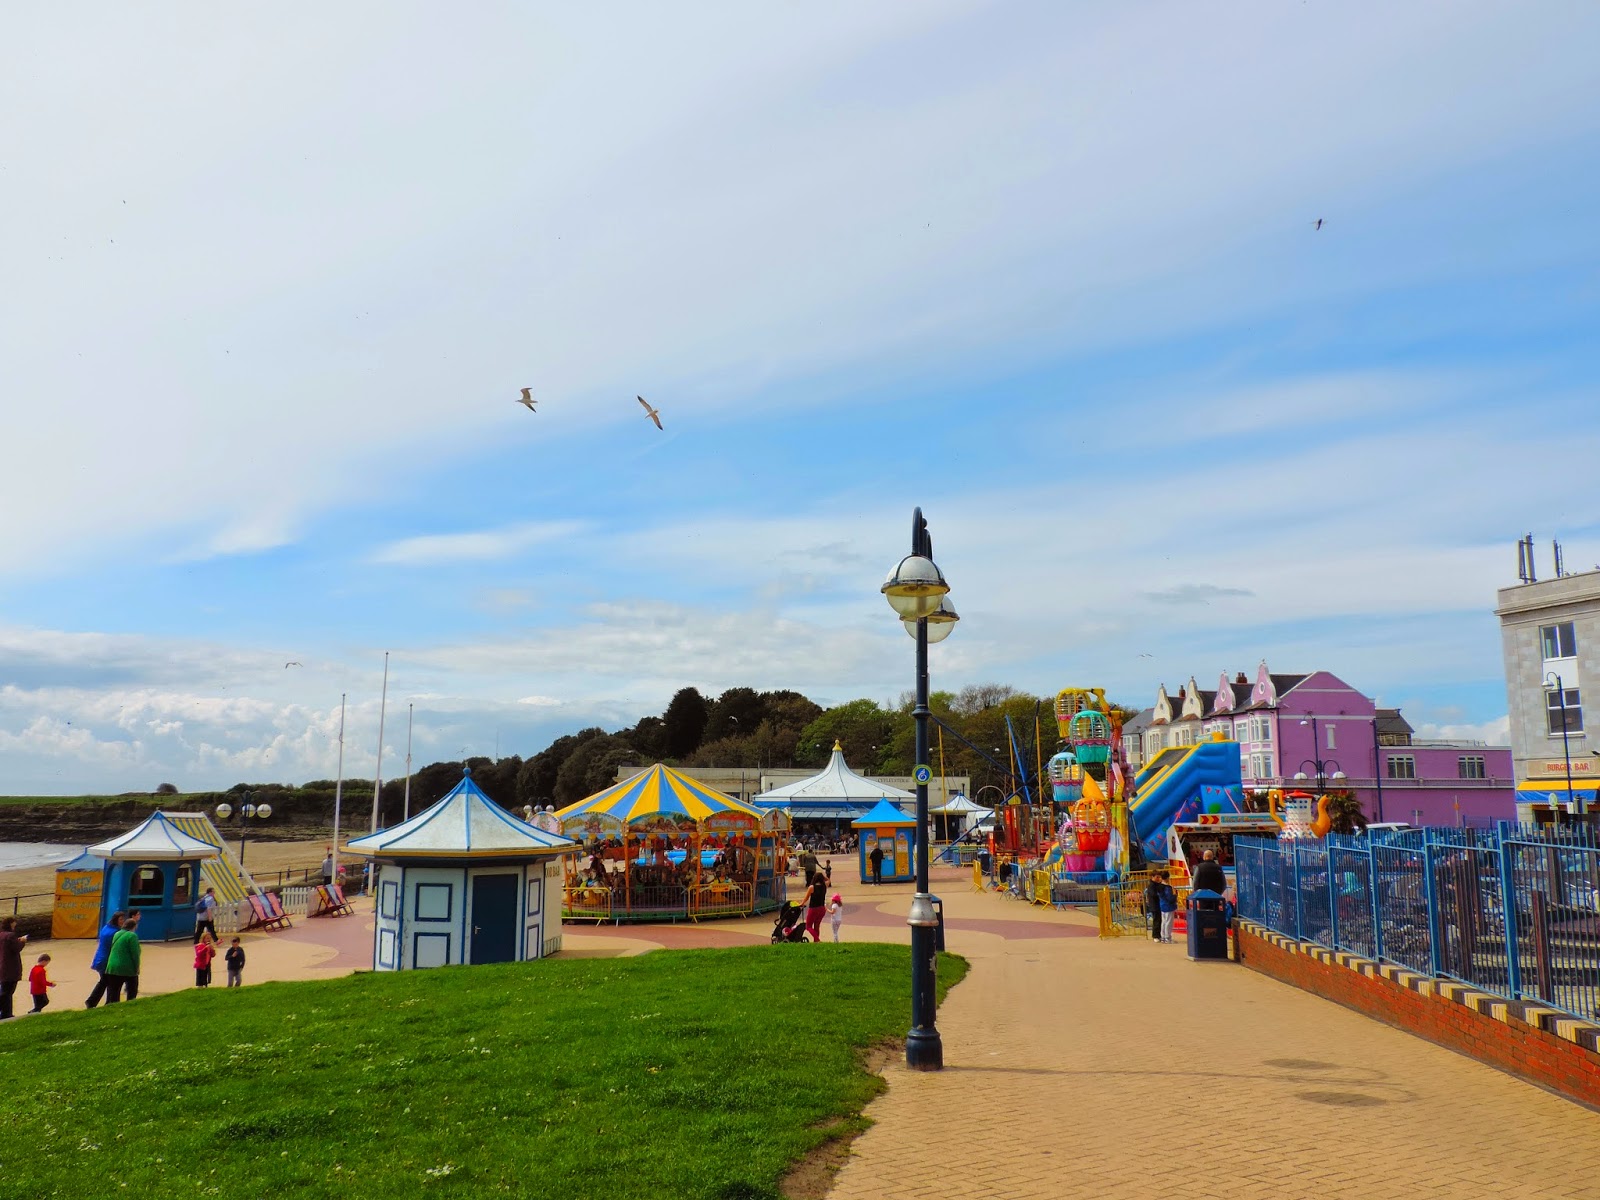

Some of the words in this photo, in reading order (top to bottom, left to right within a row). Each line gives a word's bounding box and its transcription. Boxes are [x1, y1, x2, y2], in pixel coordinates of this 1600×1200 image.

[1547, 763, 1572, 772] BURGER
[1574, 762, 1589, 771] BAR
[62, 877, 92, 890] Barry
[71, 883, 100, 895] Island
